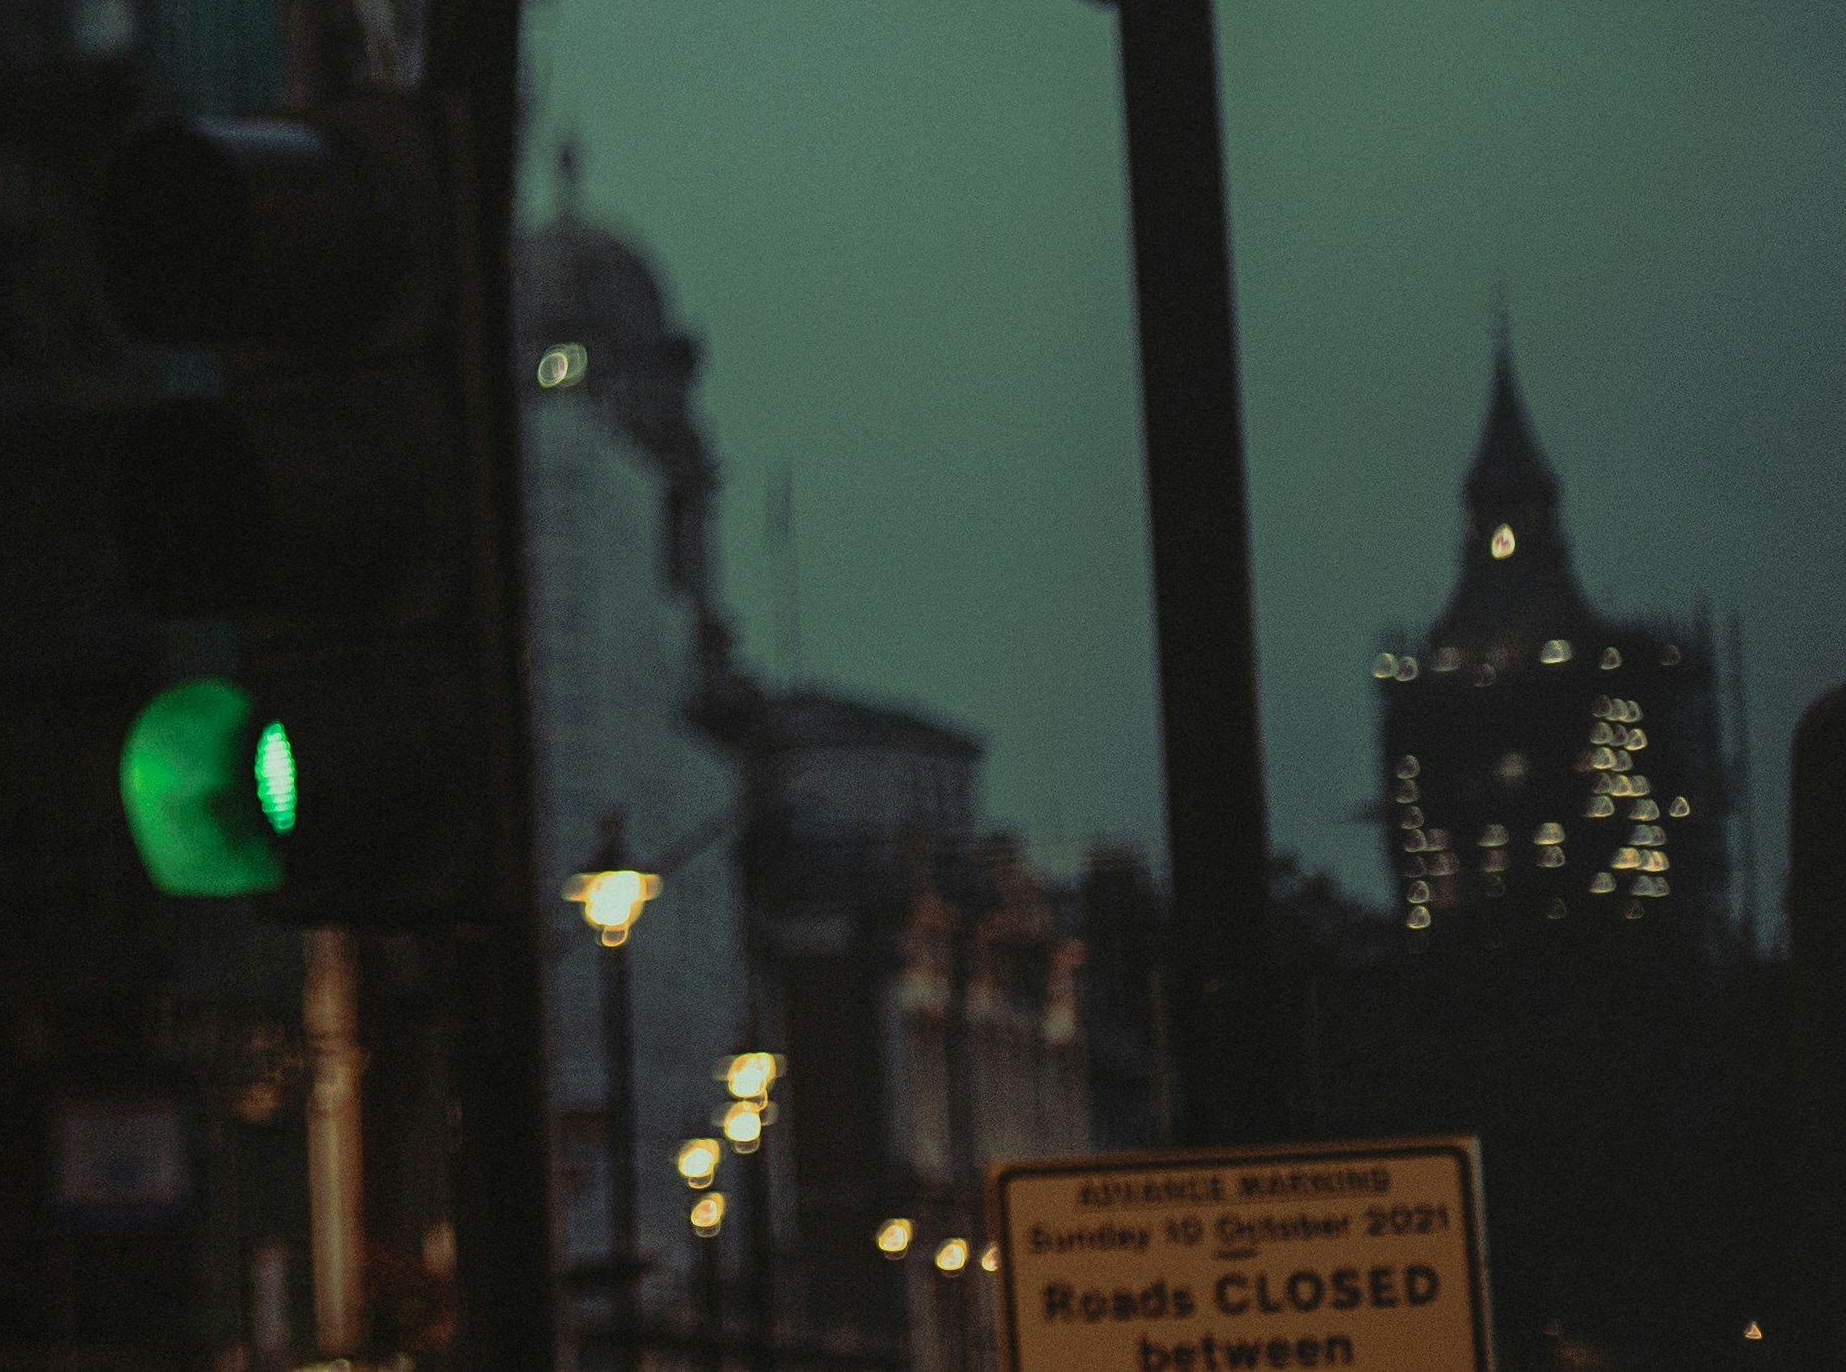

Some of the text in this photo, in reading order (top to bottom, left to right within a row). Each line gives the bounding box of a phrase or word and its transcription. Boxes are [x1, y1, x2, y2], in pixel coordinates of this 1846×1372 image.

[1238, 1168, 1391, 1199] WARNING
[1029, 1204, 1449, 1254] Sunday 10 October 2021
[1044, 1263, 1440, 1323] Roads CLOSED
[1139, 1334, 1355, 1372] between
